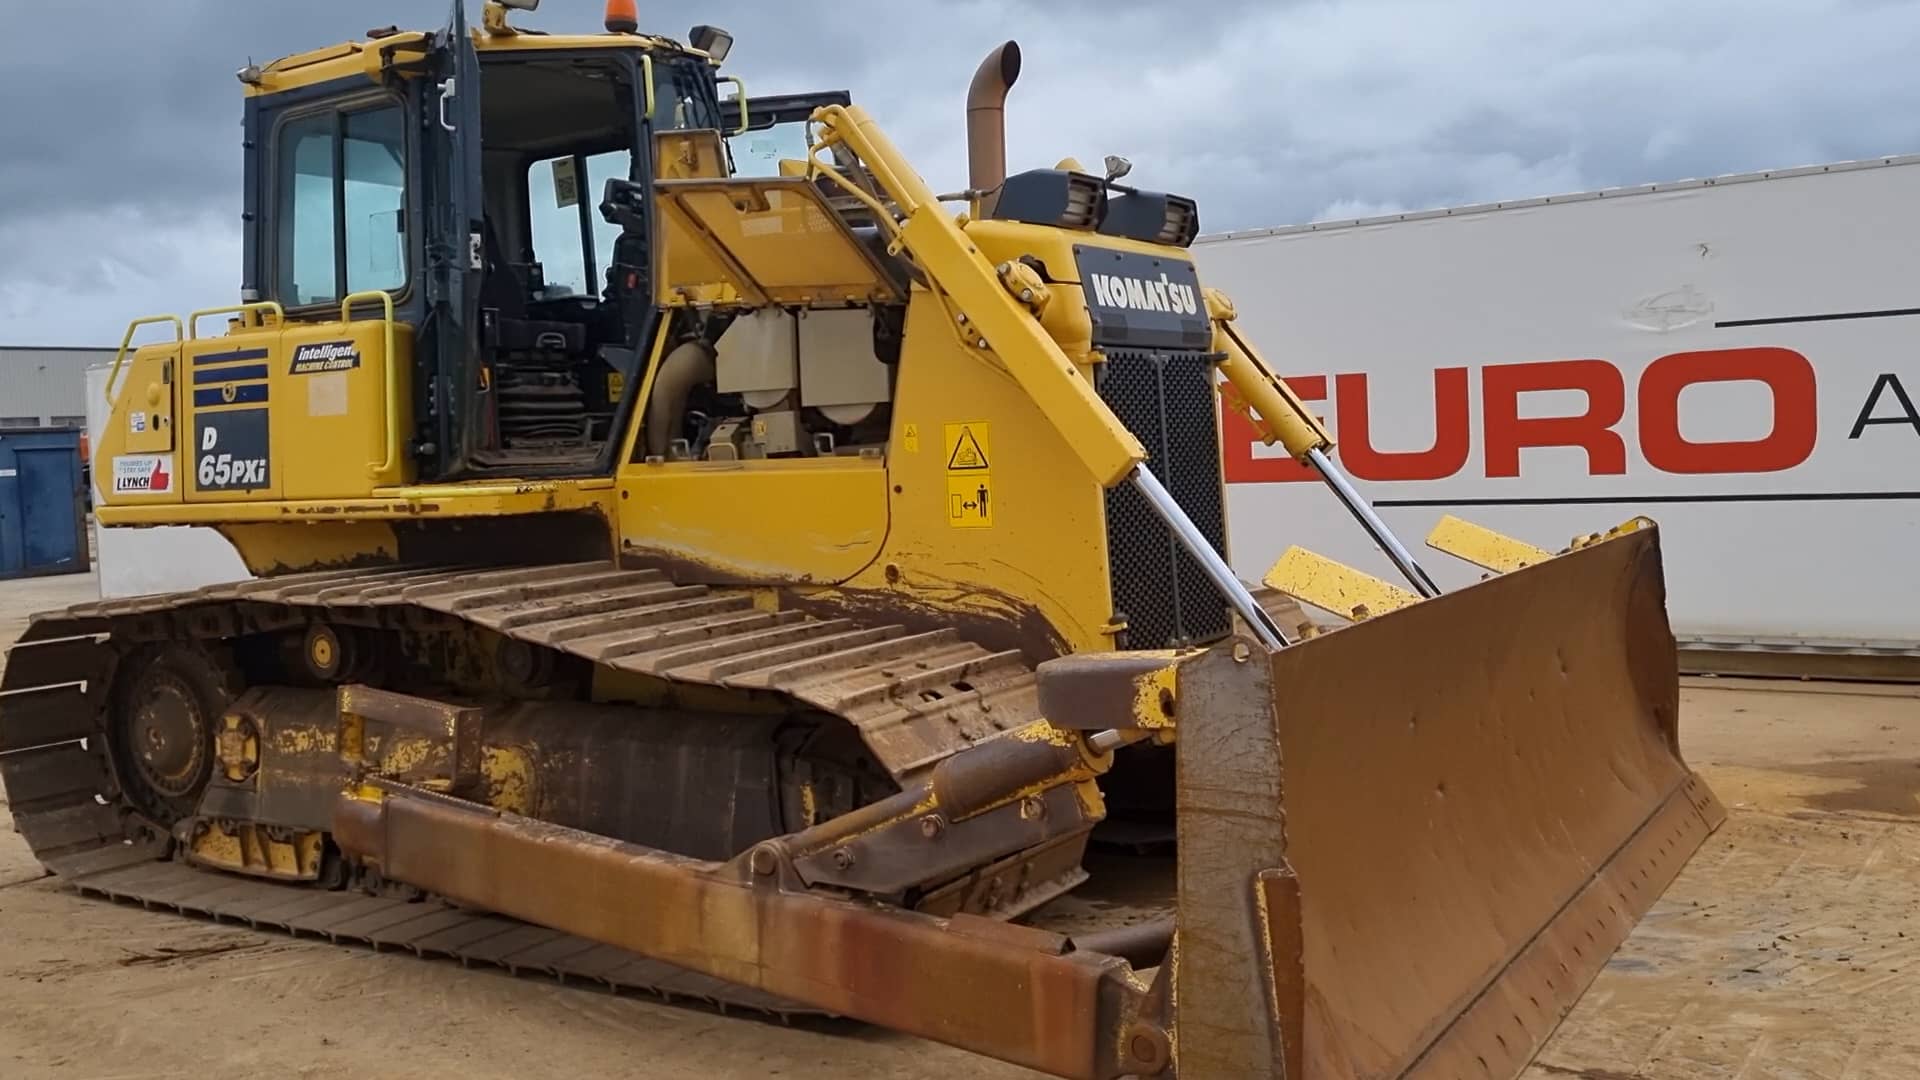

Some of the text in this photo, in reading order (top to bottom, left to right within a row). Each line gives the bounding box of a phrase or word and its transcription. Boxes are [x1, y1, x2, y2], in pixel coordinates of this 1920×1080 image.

[1091, 273, 1197, 315] KOMATSU
[1221, 347, 1817, 484] EURO
[202, 427, 217, 450] D
[199, 454, 266, 486] 65PXi
